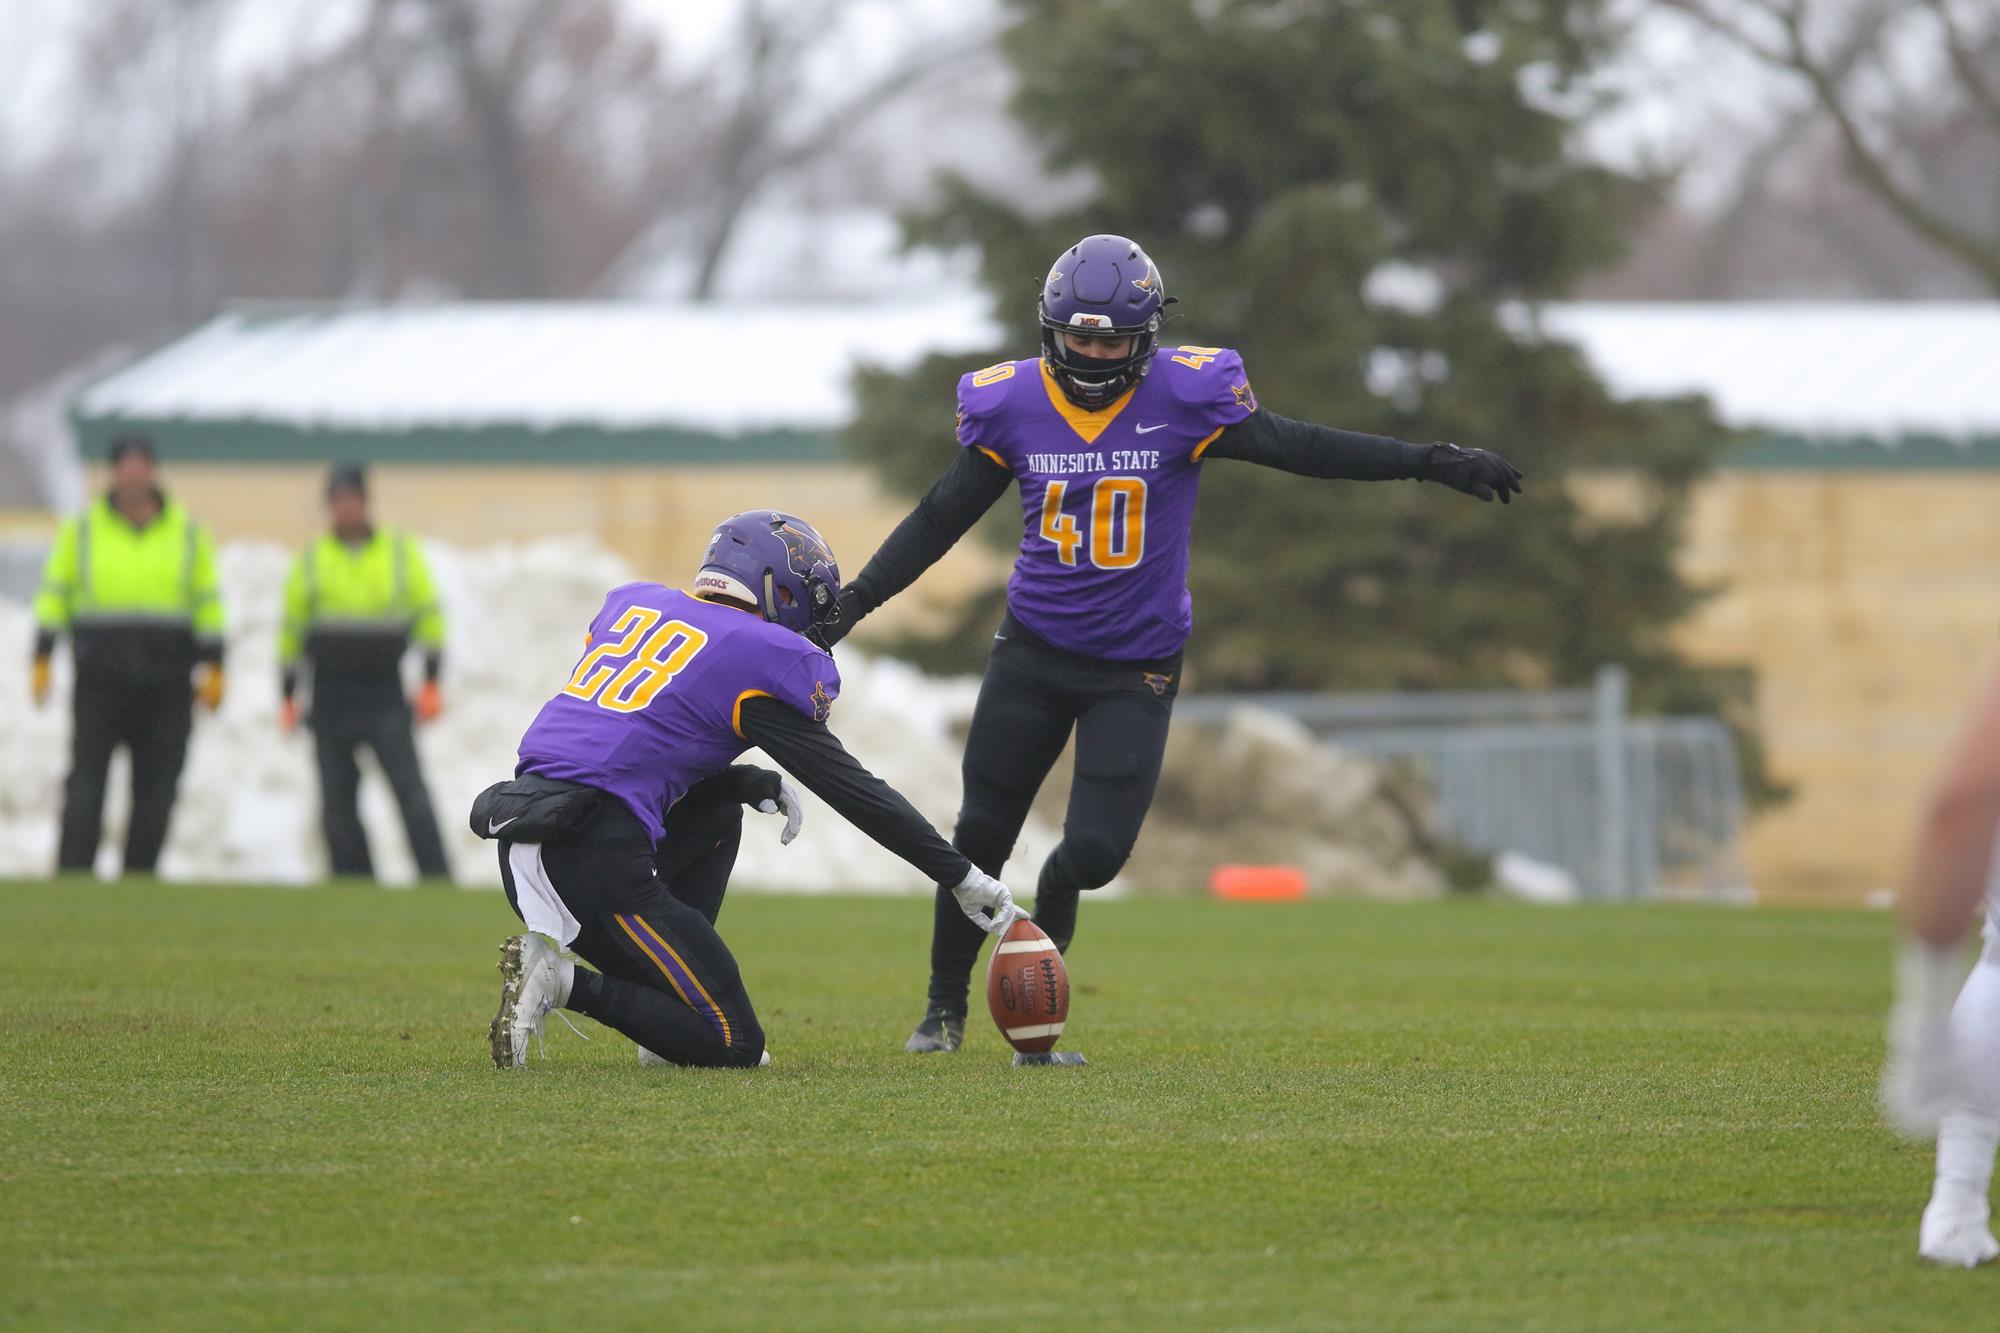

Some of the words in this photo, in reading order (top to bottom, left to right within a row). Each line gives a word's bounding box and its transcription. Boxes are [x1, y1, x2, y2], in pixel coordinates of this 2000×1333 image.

[1025, 452, 1106, 474] MINNESOTA
[1112, 450, 1160, 471] STATE
[1039, 475, 1148, 570] 40
[562, 605, 708, 713] 28
